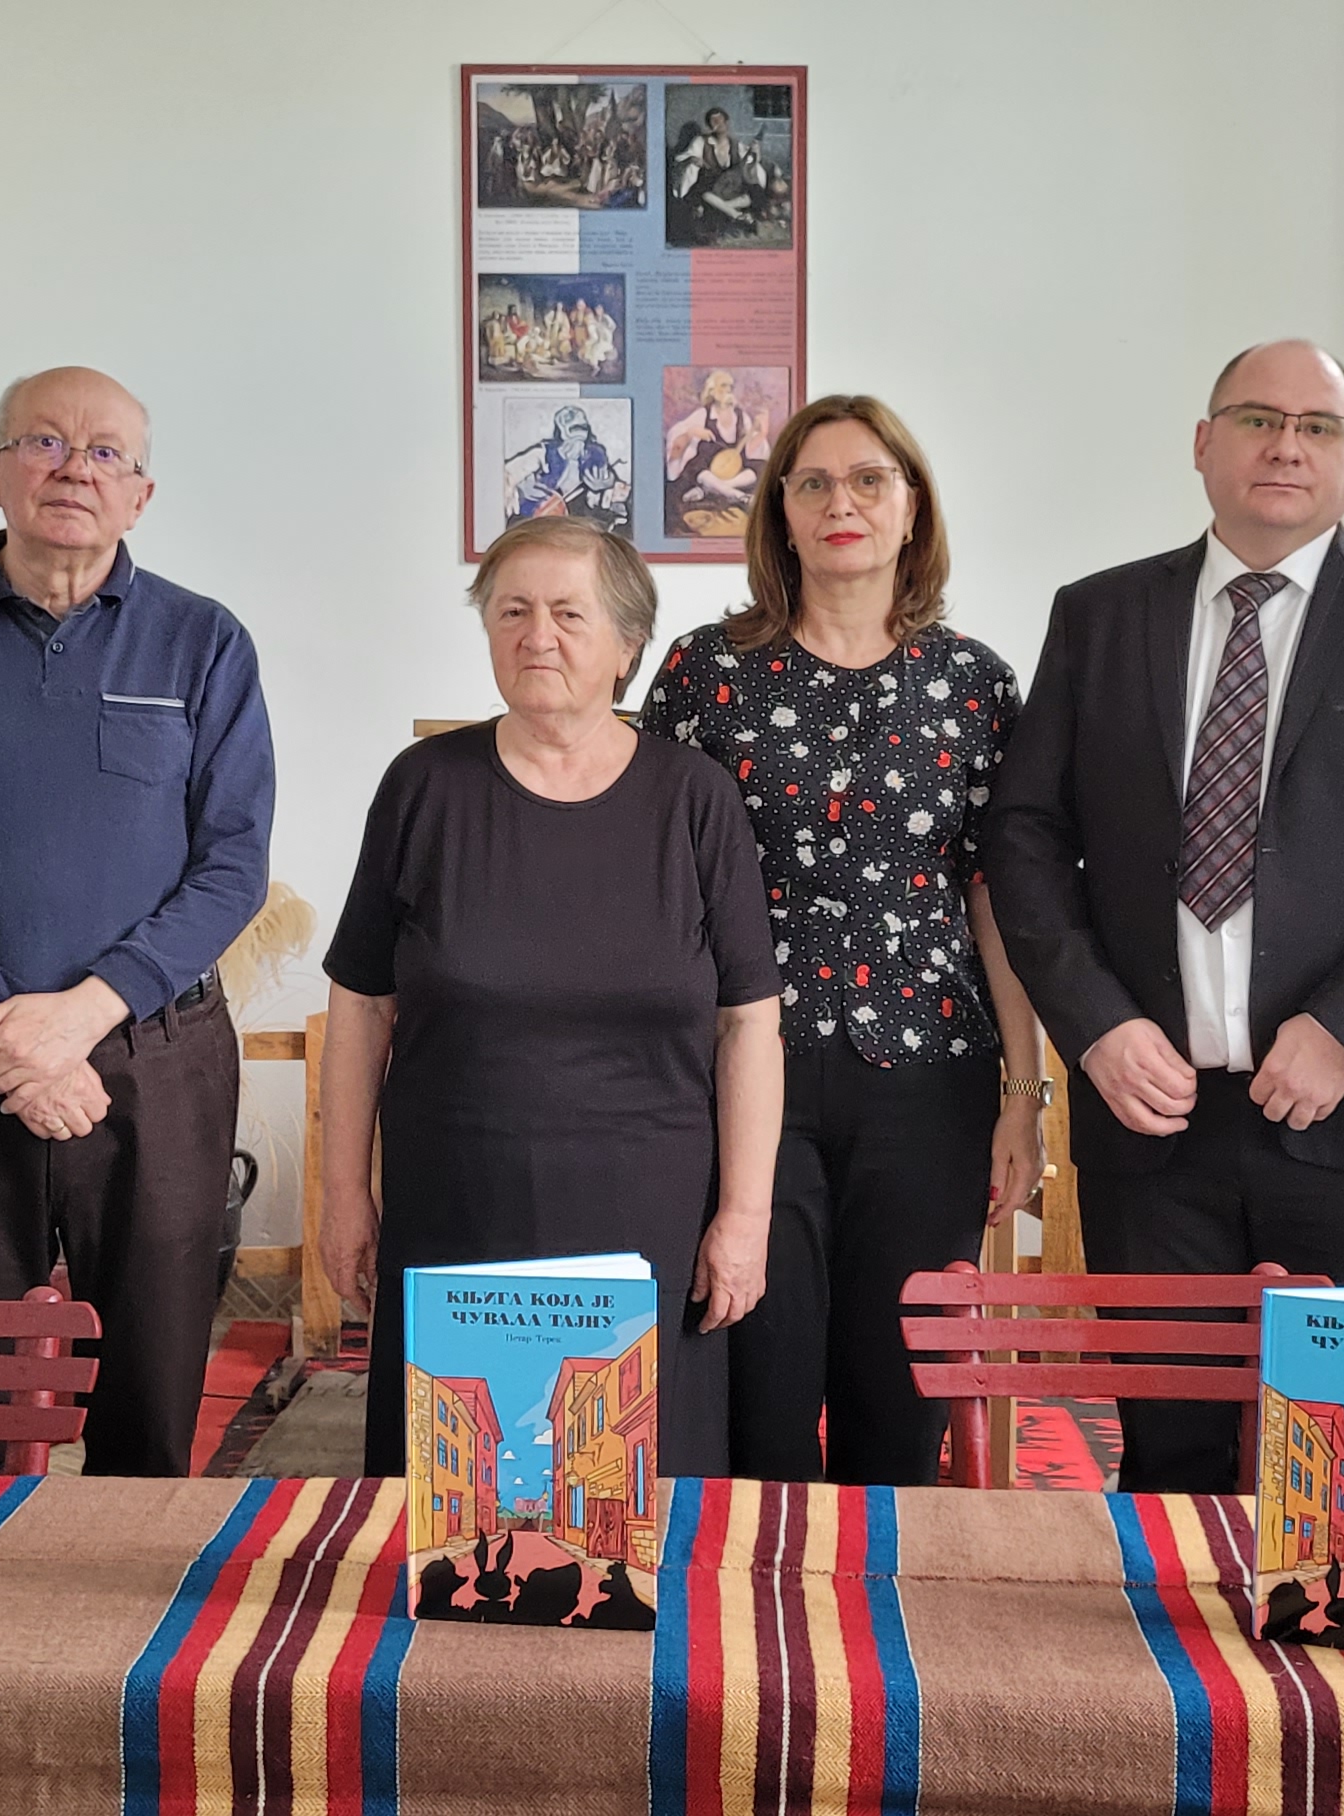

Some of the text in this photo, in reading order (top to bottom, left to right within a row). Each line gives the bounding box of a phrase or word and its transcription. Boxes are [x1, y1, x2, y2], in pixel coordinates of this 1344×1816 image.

[446, 1290, 616, 1309] КЊИГА КОЈА ЈЕ
[452, 1310, 542, 1327] ЧУВАЛА
